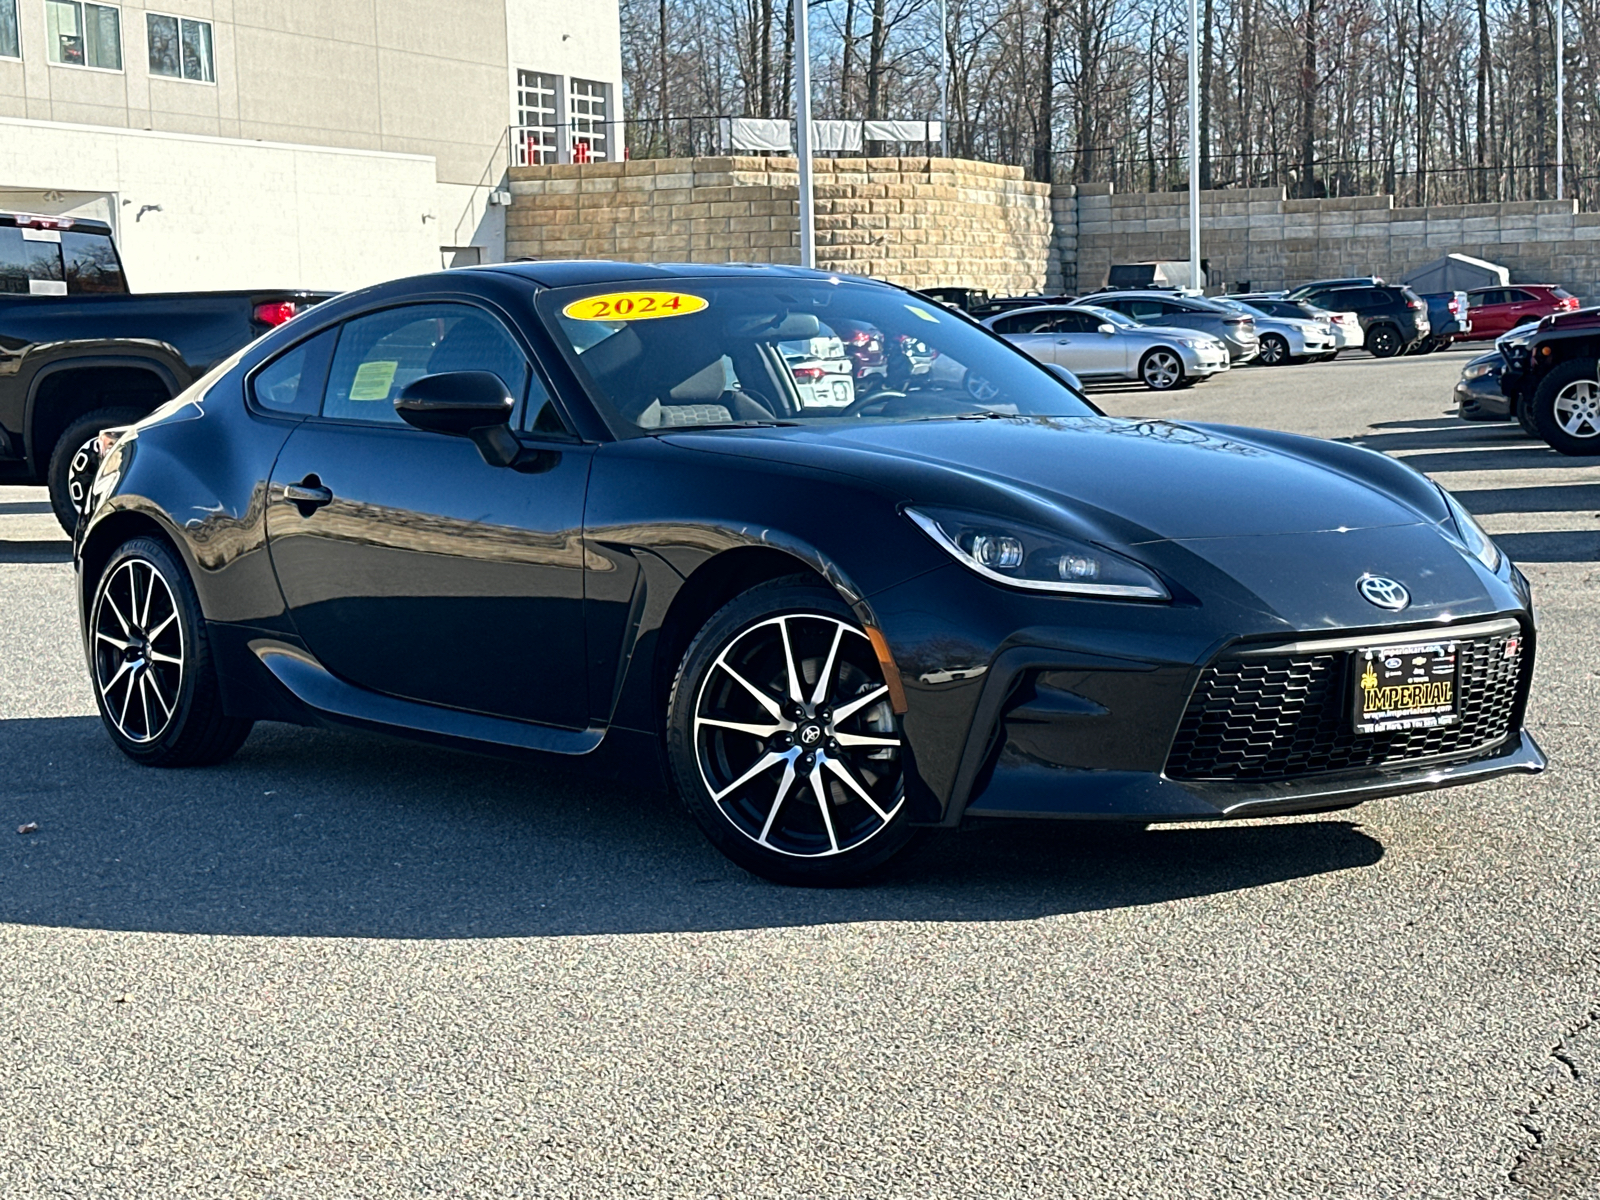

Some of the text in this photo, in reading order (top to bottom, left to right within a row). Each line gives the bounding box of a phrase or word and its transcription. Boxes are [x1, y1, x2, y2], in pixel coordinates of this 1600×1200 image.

[591, 295, 682, 318] 2024
[1363, 681, 1453, 712] IMPERIAL
[1363, 705, 1453, 719] www.imperialcars.com
